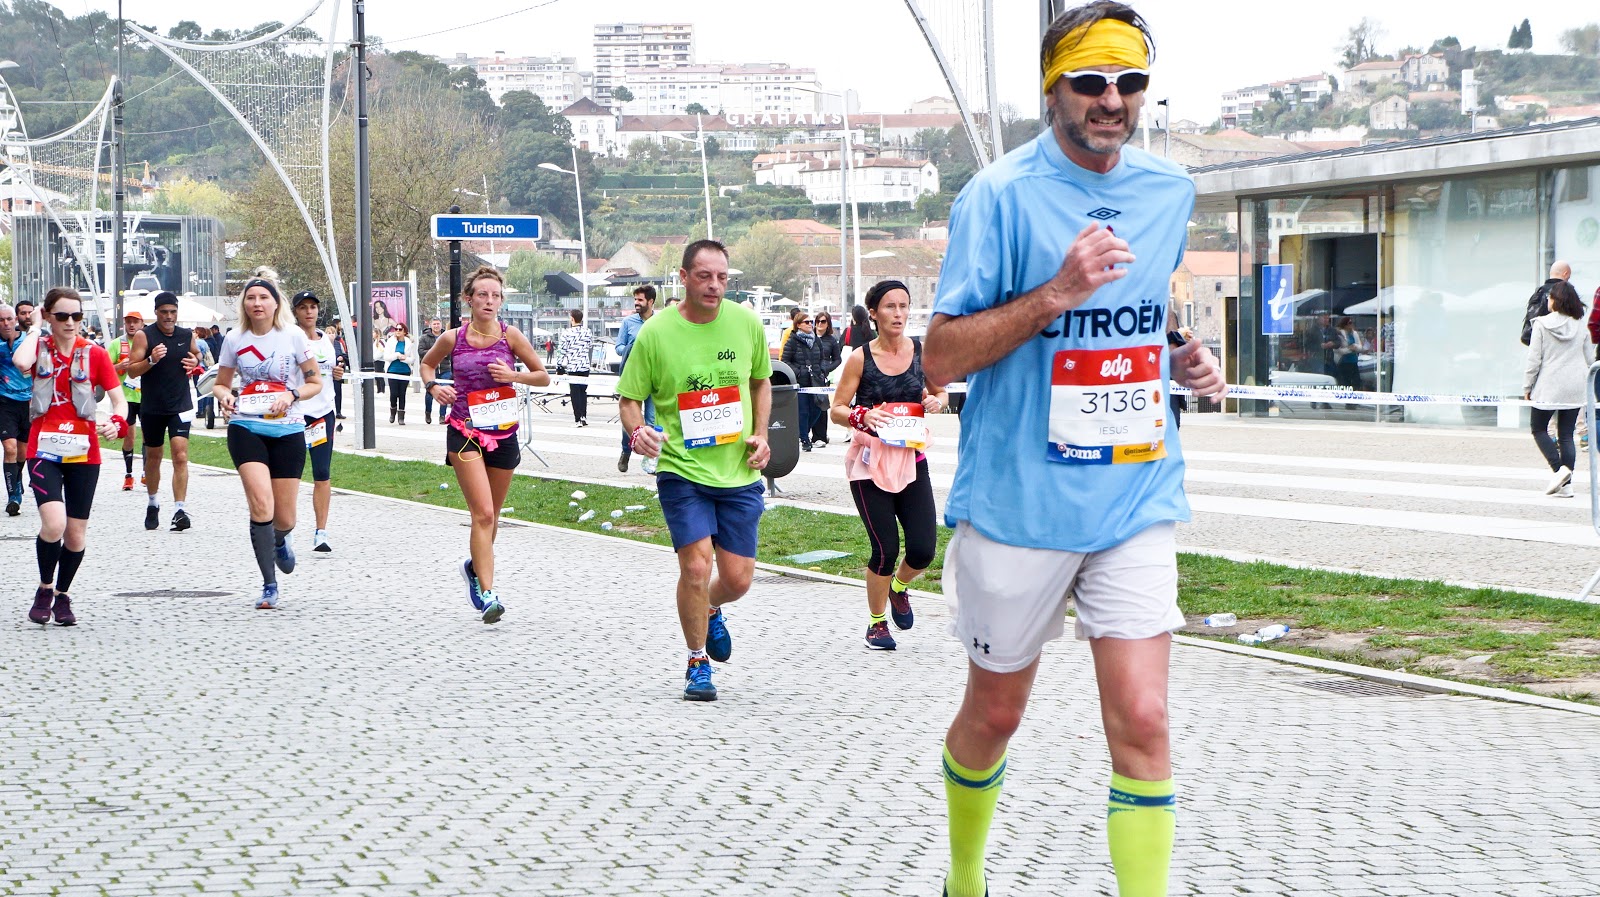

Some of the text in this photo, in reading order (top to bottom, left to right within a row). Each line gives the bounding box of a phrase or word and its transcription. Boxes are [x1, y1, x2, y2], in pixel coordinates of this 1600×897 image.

[725, 112, 842, 125] GRAHAM'S
[461, 221, 515, 234] Turismo
[371, 288, 403, 298] ZENiS
[717, 349, 736, 362] edp
[1100, 353, 1132, 381] edp
[255, 382, 269, 392] edp
[485, 390, 500, 401] edp
[701, 392, 719, 405] edp
[1080, 388, 1146, 414] 3136
[692, 406, 731, 423] 8026
[893, 404, 908, 415] edp
[58, 421, 74, 433] edp
[1099, 425, 1129, 435] JESUS
